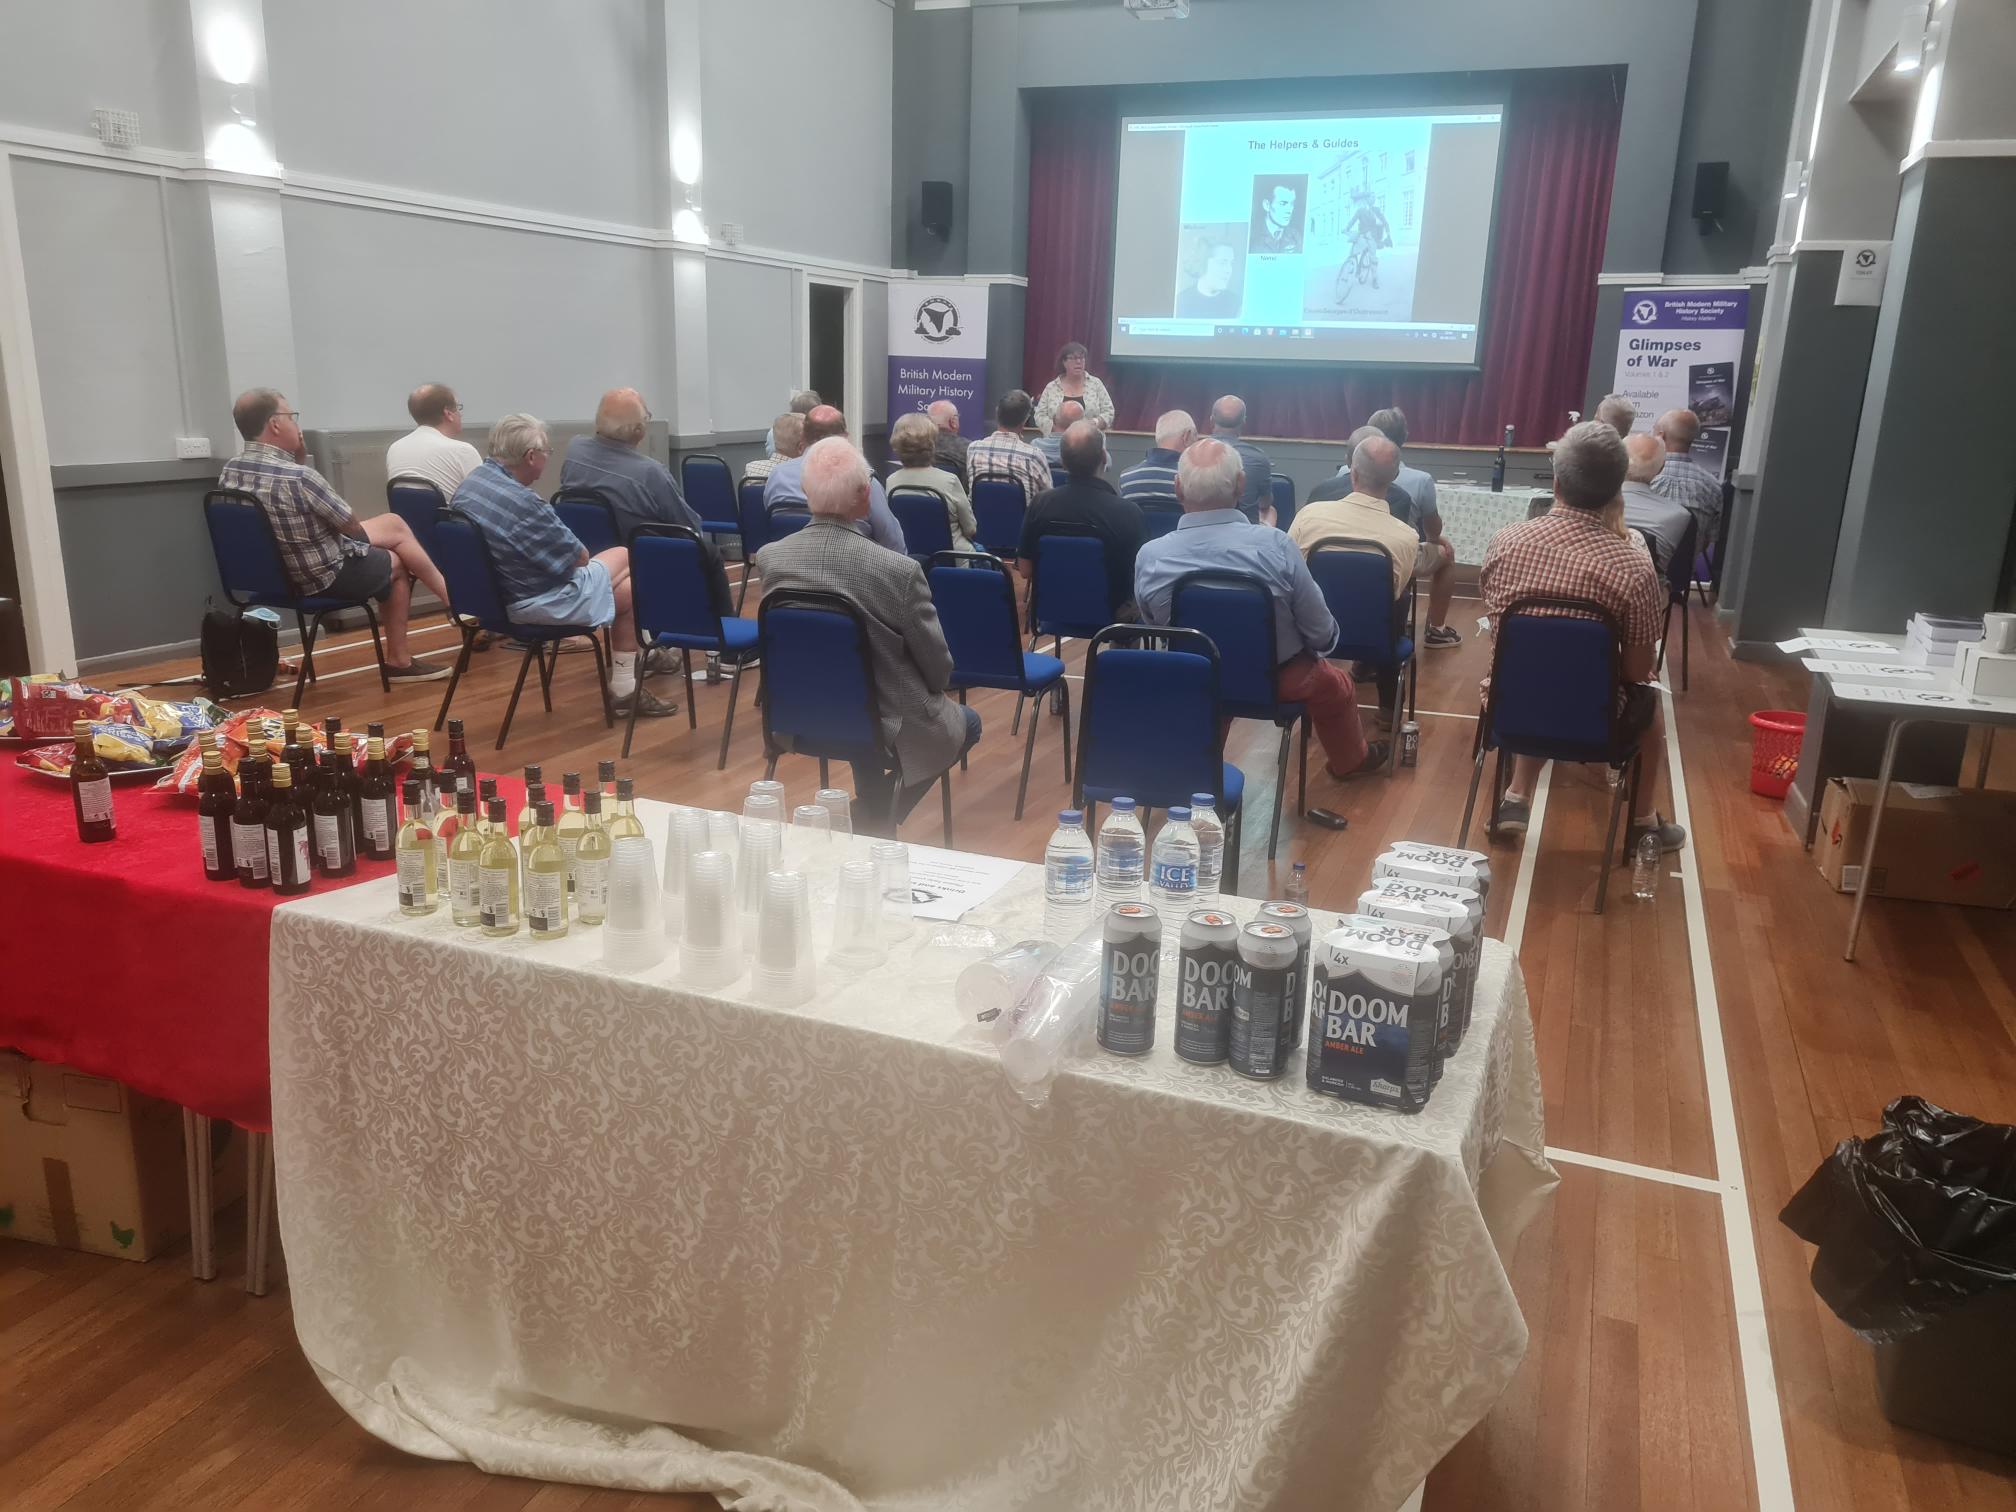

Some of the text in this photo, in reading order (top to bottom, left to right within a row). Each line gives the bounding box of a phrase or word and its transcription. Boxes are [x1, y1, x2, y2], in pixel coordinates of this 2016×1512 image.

[1248, 138, 1359, 151] The Helpers & Guides
[1675, 308, 1725, 316] History Society
[1712, 300, 1738, 309] Military
[1626, 338, 1702, 367] Glimpses of War
[900, 368, 972, 381] British Modern
[897, 384, 974, 399] Military History
[1622, 390, 1660, 398] Available
[1397, 851, 1466, 868] DOOM
[1427, 850, 1469, 862] BAR
[1160, 865, 1190, 882] ICE
[1380, 889, 1427, 902] BAR
[1385, 882, 1460, 900] DOOM
[1344, 928, 1427, 951] DOOM
[1381, 926, 1430, 941] BAR
[1233, 964, 1252, 989] OM
[1182, 982, 1229, 1011] BAR
[1329, 989, 1410, 1028] DOOM
[1326, 1015, 1377, 1048] BAR
[1325, 1040, 1365, 1055] AMBER ALE
